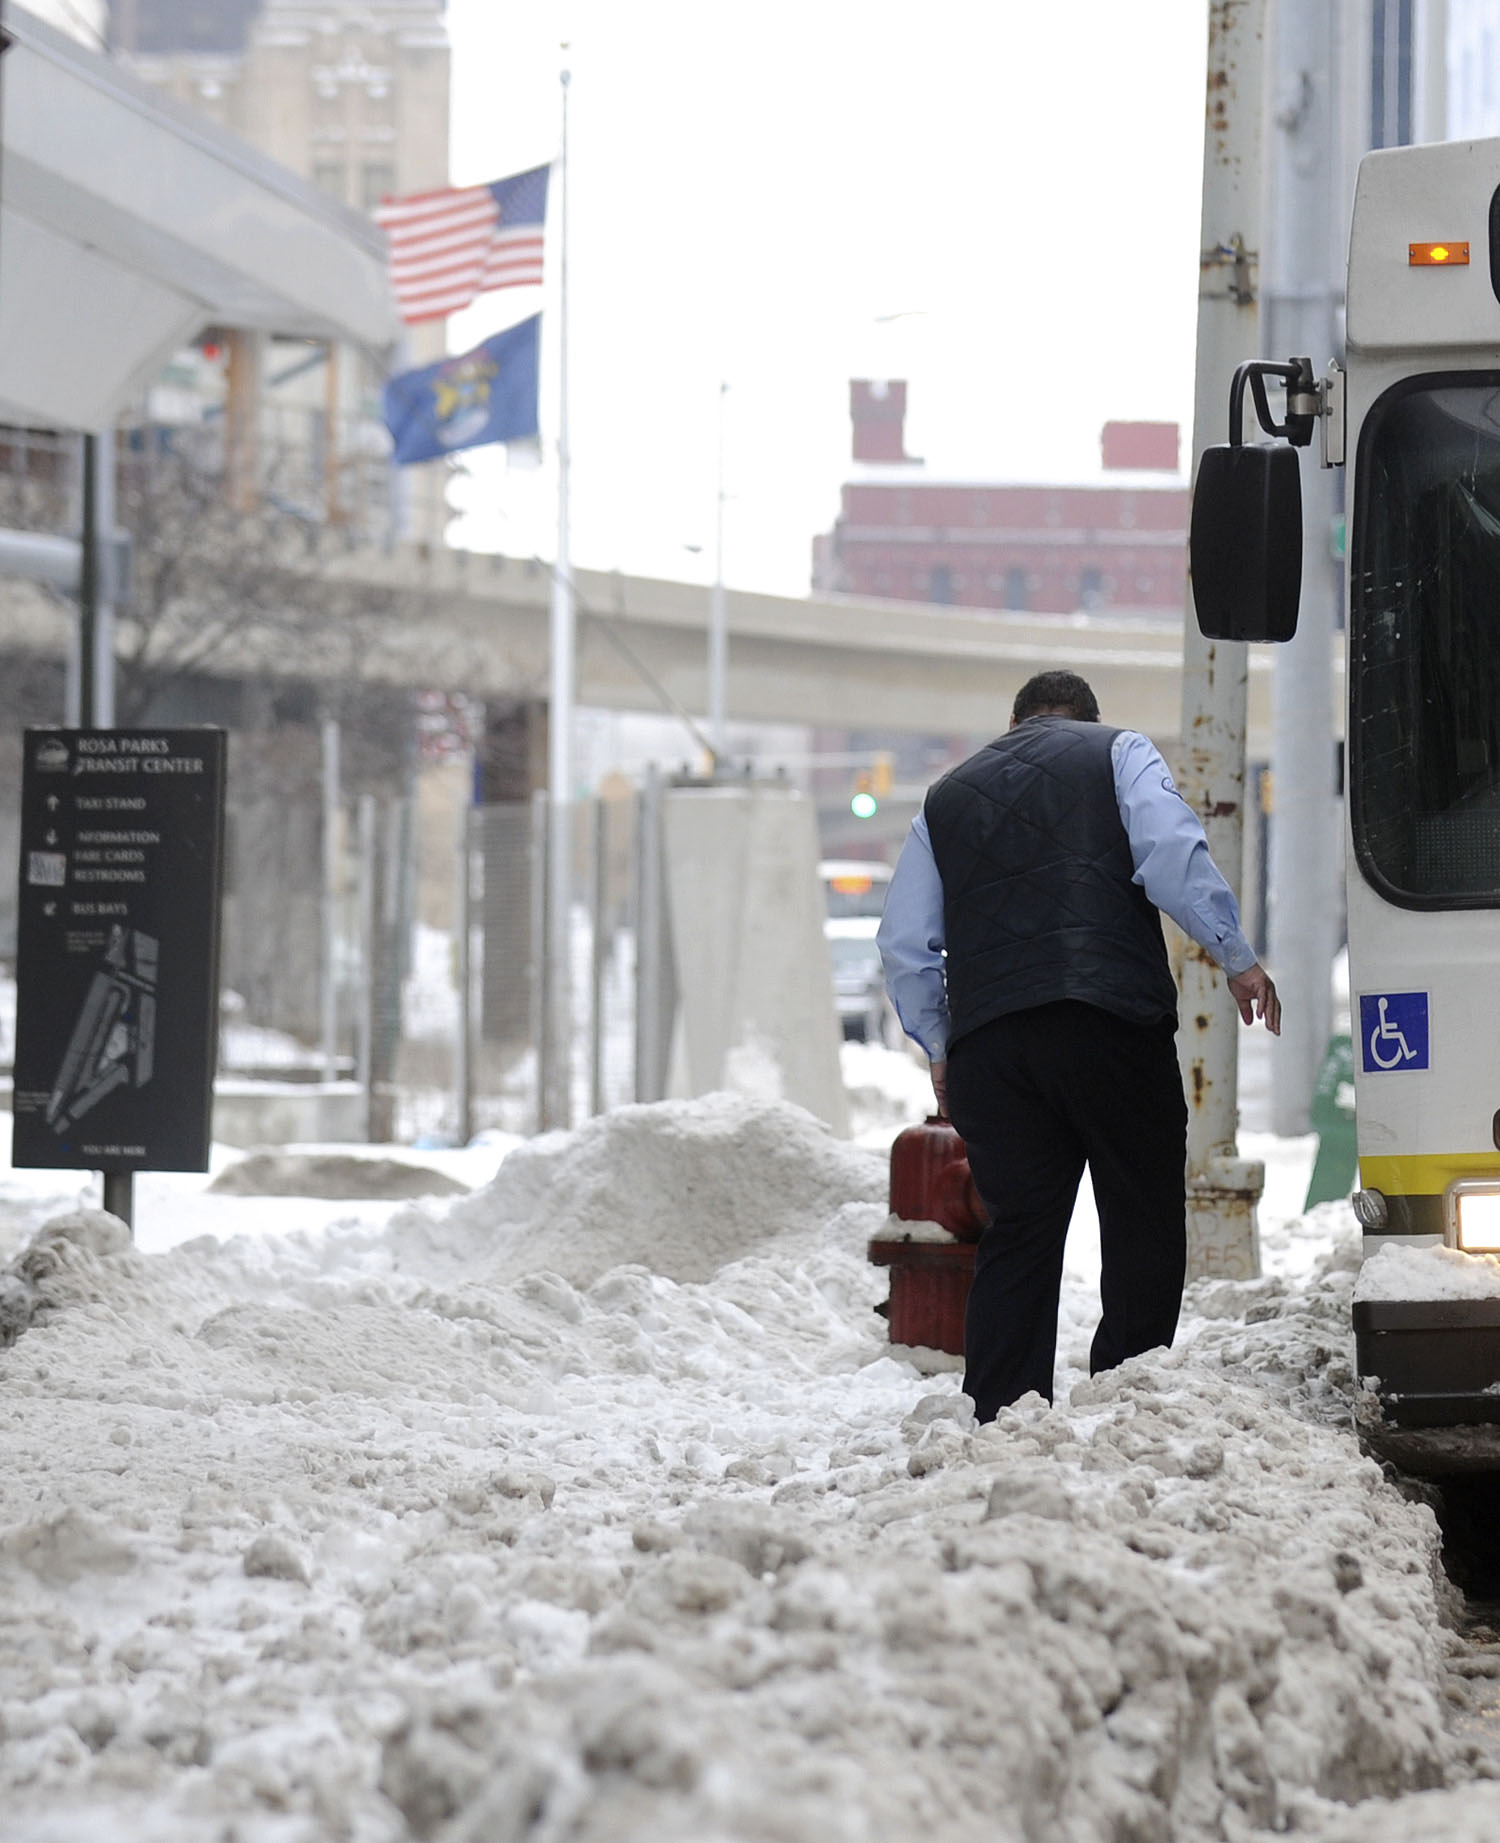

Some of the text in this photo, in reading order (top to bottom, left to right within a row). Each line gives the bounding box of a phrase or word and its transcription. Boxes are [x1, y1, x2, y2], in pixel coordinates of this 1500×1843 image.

[78, 738, 170, 753] ROSA PARKS
[76, 757, 204, 774] TRANSIT CENTER
[76, 797, 147, 810] TAXI STAND
[77, 831, 161, 843] INFORMATION
[105, 850, 145, 862] CARDS
[74, 870, 146, 882] RESTROOMS
[72, 903, 128, 915] BUS BAYS
